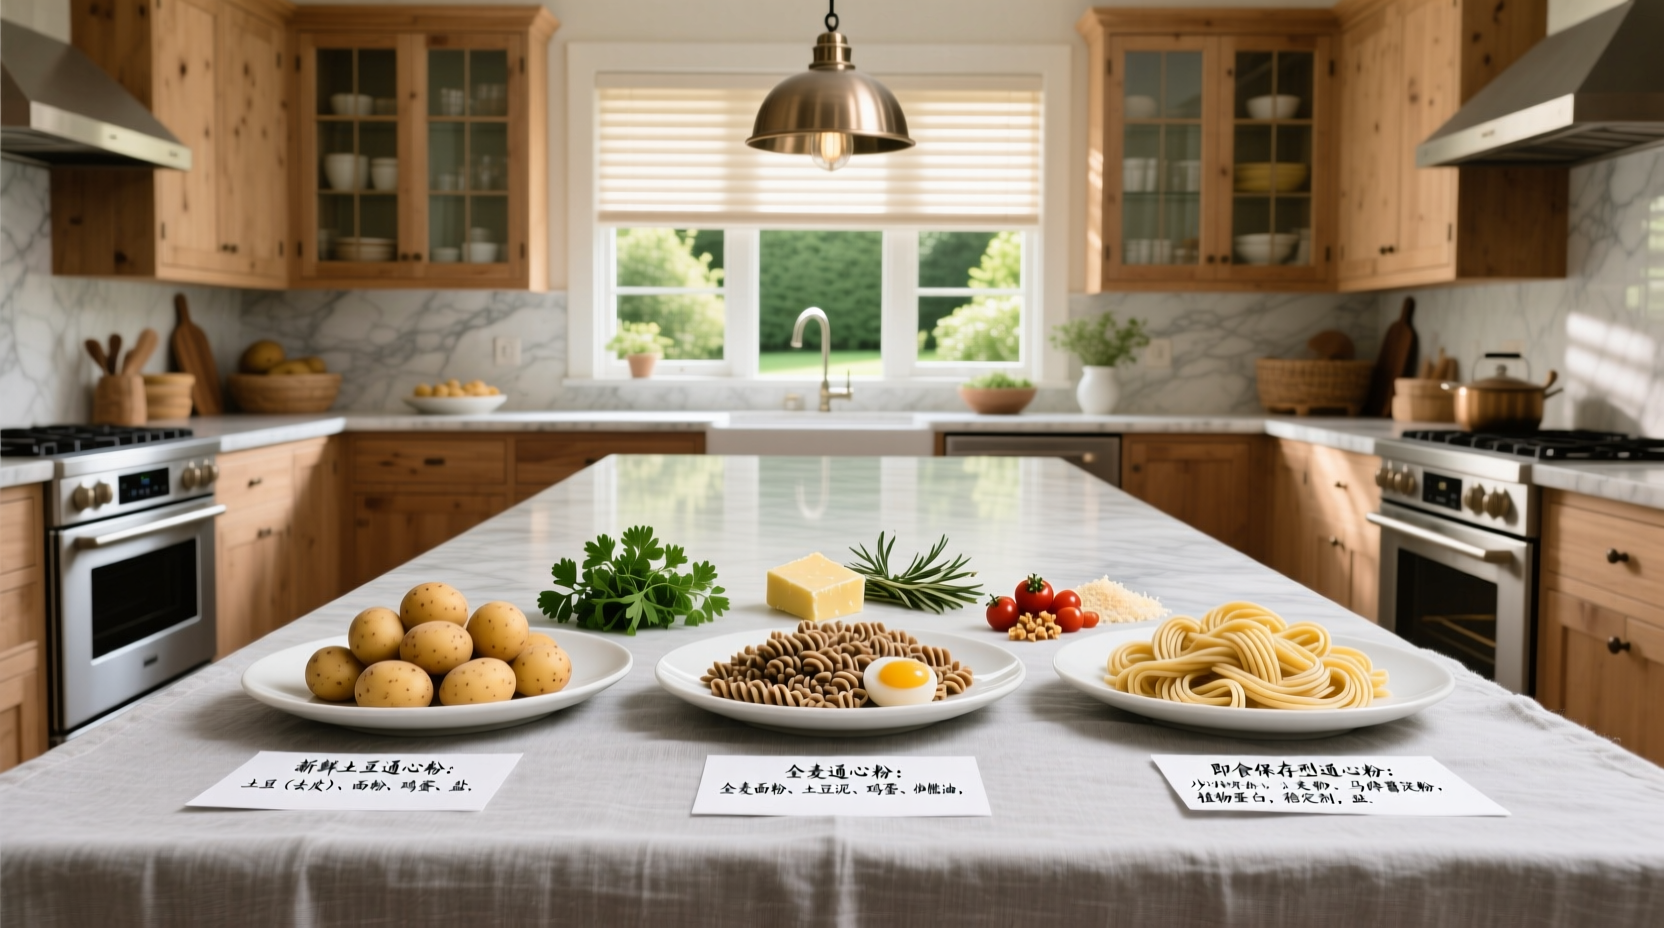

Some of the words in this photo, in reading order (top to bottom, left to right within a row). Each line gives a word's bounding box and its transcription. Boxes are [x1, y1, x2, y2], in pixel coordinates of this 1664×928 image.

[784, 762, 901, 779] 全麦通心粉：
